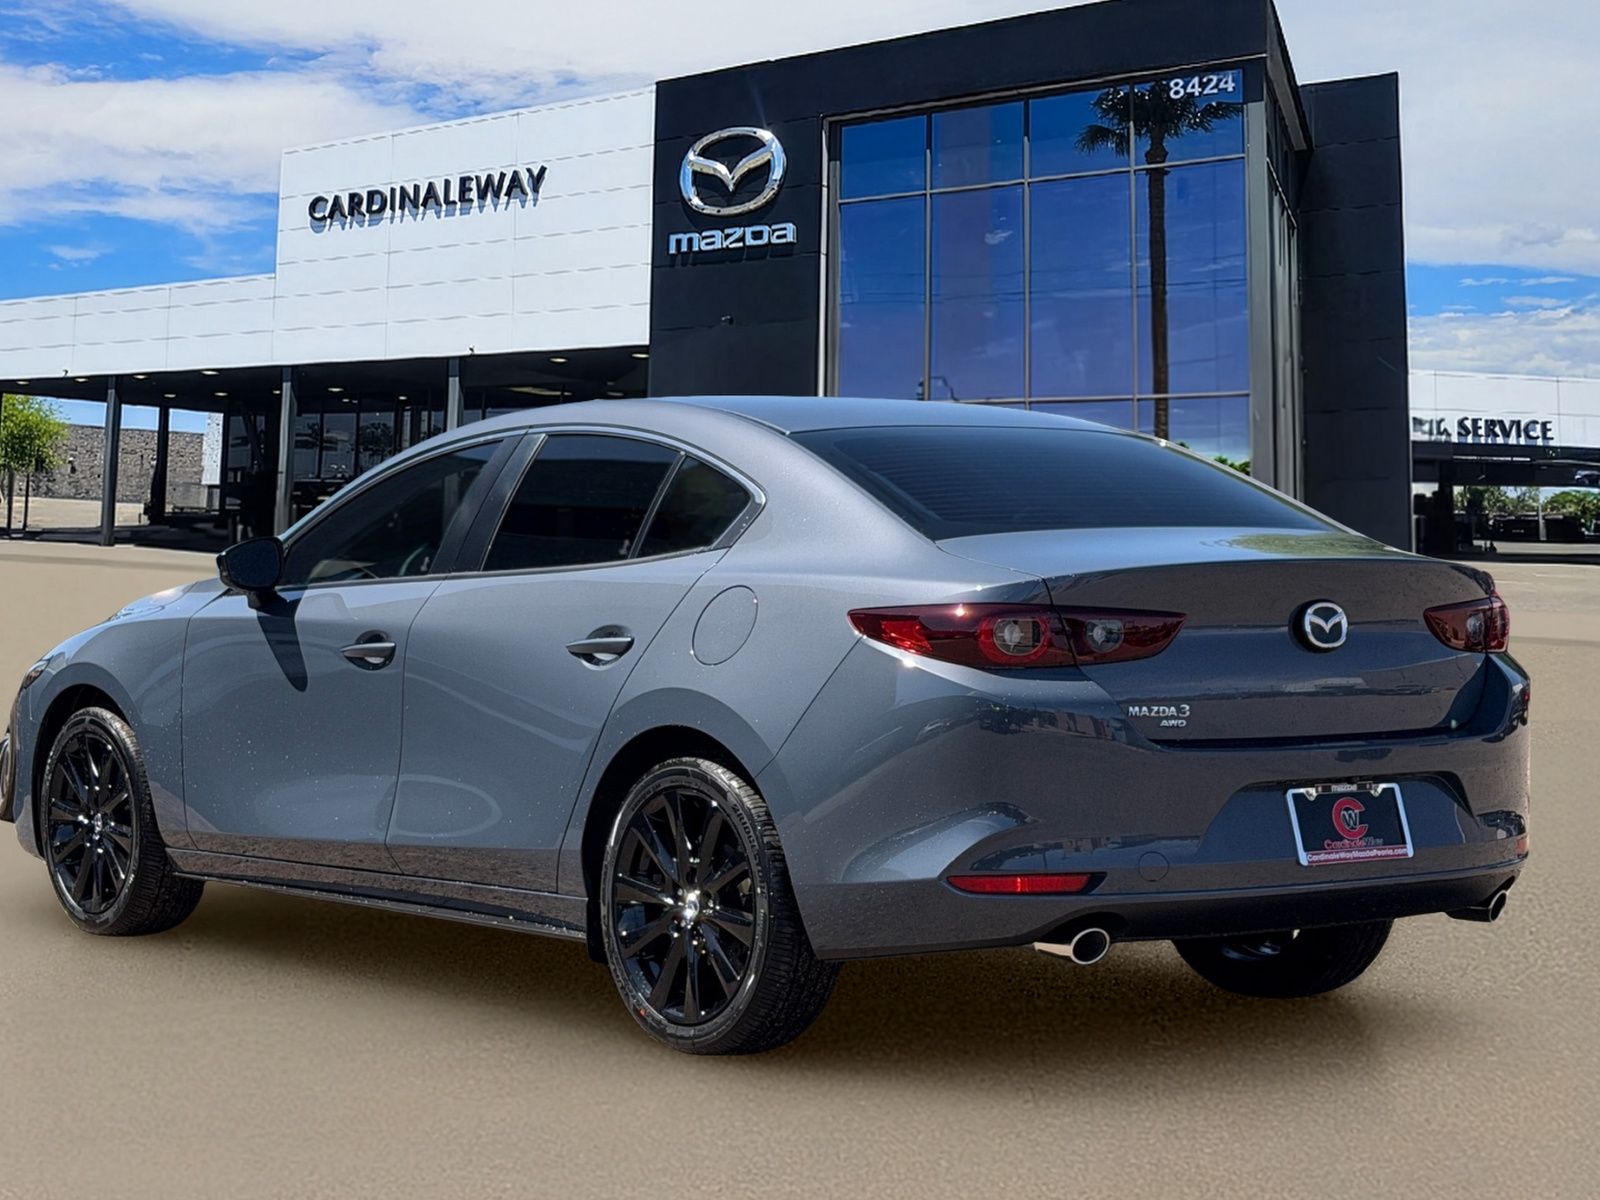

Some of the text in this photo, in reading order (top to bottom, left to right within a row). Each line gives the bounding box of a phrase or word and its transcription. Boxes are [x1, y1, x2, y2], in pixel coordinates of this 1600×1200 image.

[1169, 74, 1236, 99] 8424
[308, 165, 548, 221] CARDINALEWAY
[668, 222, 796, 254] mazda
[1457, 416, 1554, 440] SERVICE
[1160, 719, 1187, 727] AWD
